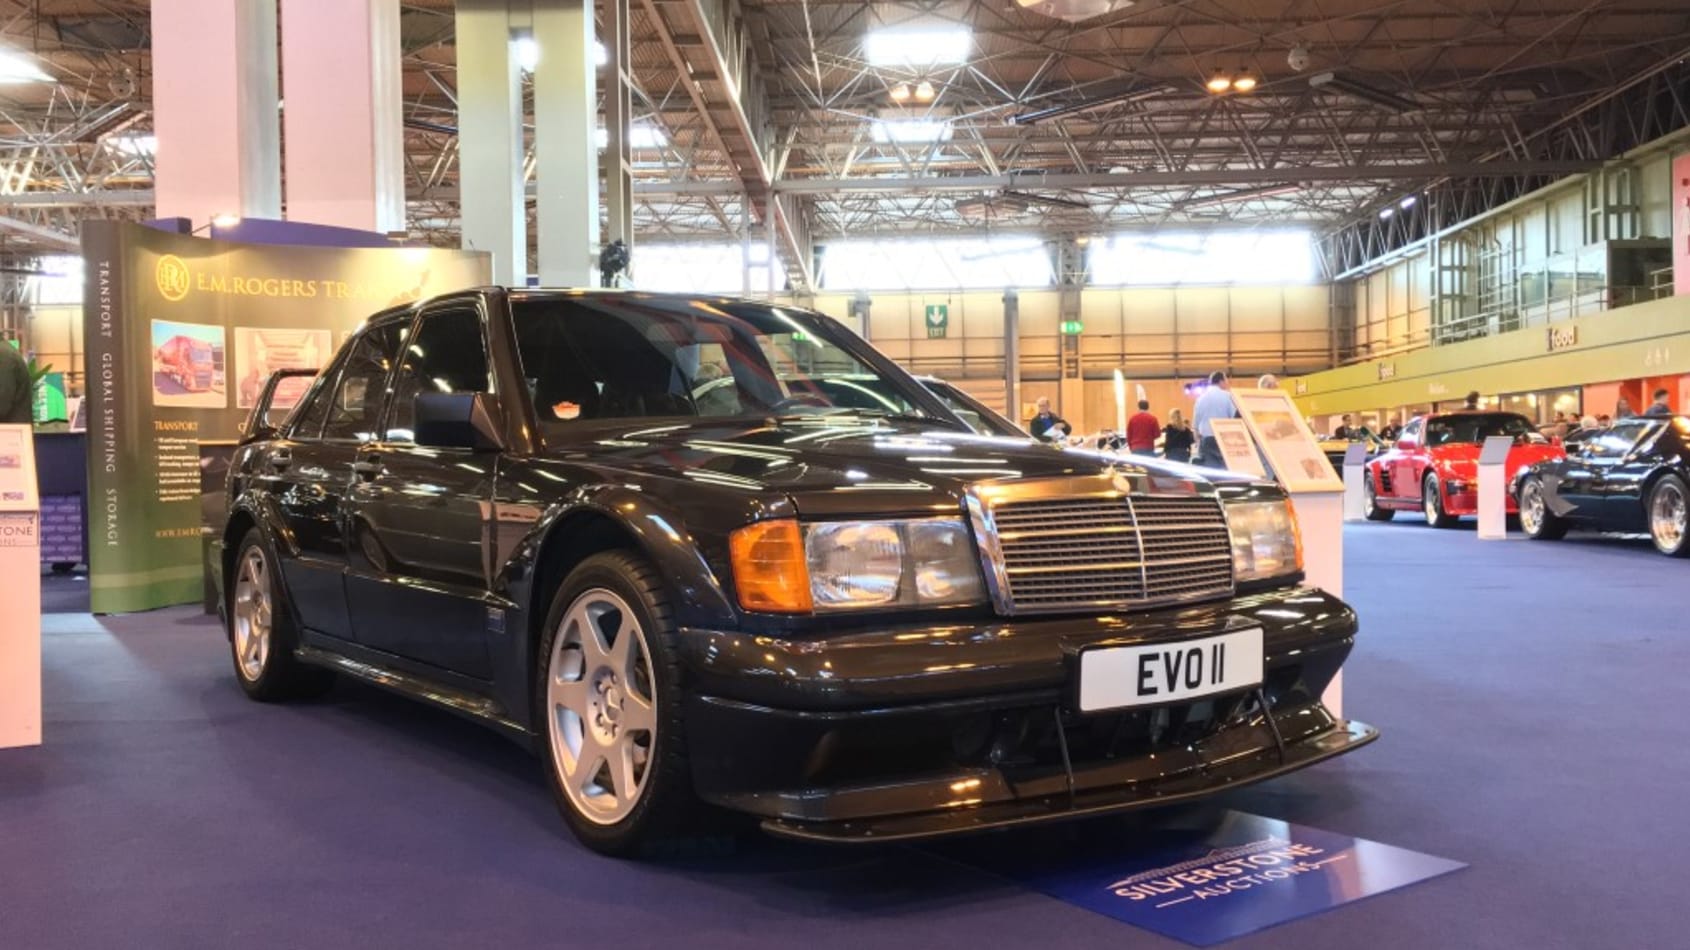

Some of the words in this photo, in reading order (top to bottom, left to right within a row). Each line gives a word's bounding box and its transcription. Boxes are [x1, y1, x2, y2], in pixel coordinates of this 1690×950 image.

[99, 261, 111, 337] TRANSPORT
[102, 353, 113, 402] GLOBAL
[104, 409, 116, 472] SHIPPING
[1137, 647, 1203, 696] EVO
[1115, 843, 1324, 900] SILVERSTONE
[1193, 861, 1321, 900] AUCTIONS
